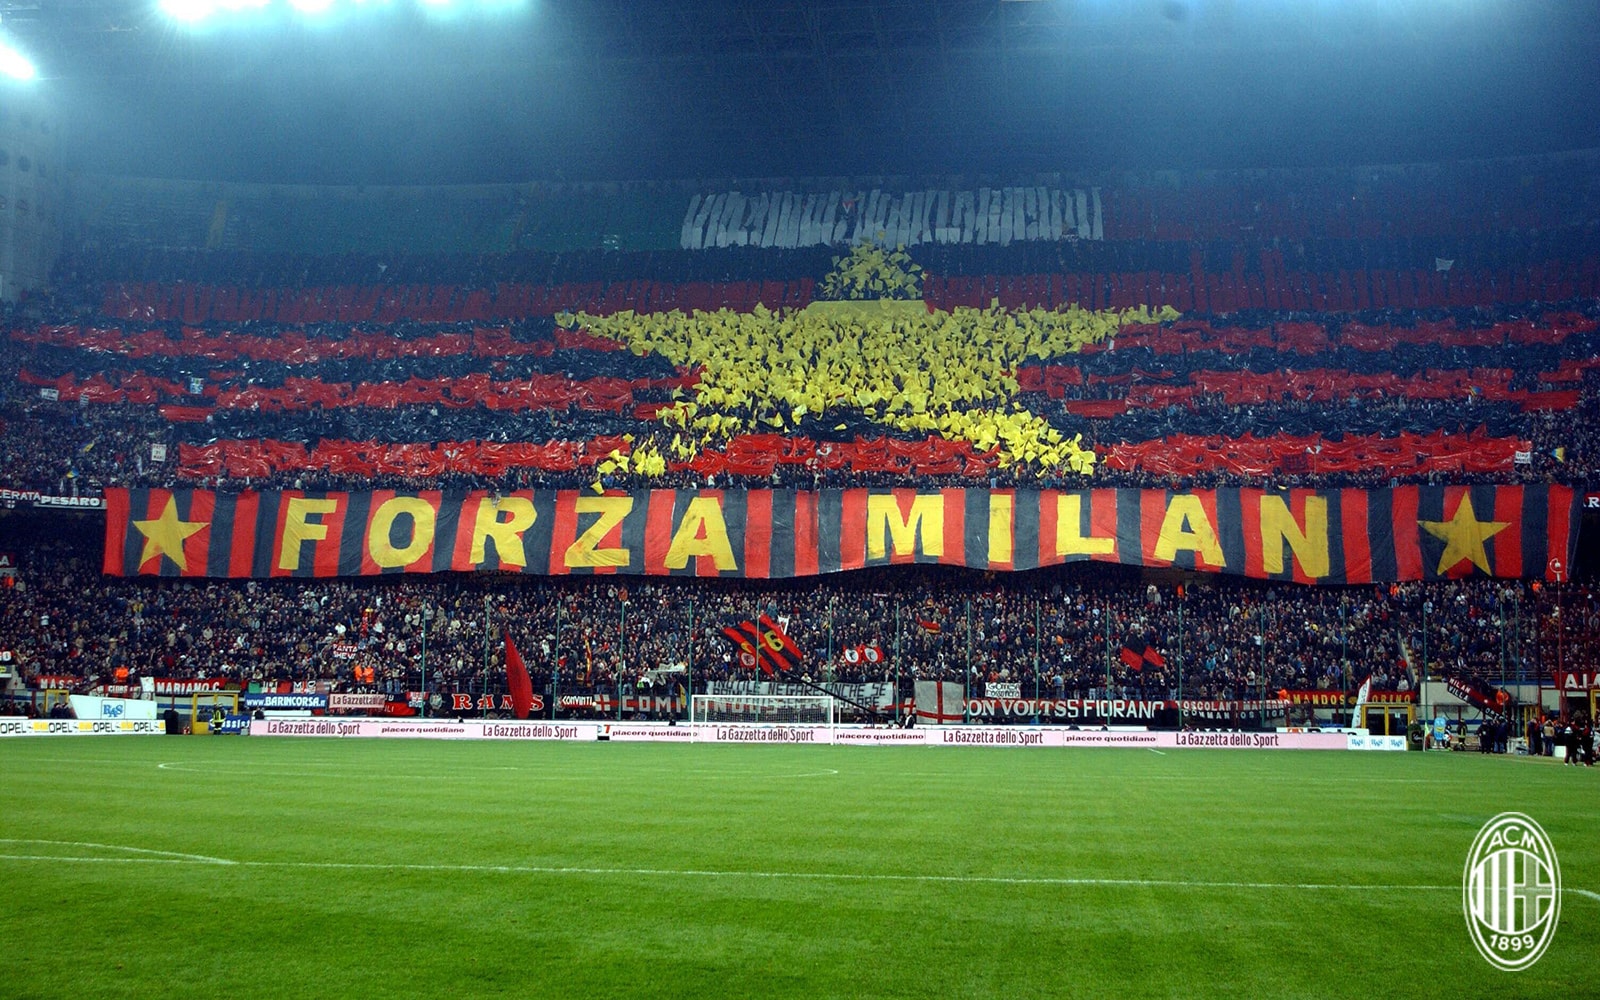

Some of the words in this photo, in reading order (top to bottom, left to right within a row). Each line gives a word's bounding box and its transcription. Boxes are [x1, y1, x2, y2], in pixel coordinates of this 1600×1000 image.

[0, 489, 40, 501] ERATA
[41, 496, 100, 506] PESARO
[1583, 496, 1600, 508] R
[279, 496, 738, 571] FORZA
[867, 494, 1330, 577] MILAN
[156, 681, 209, 695] MARIANO
[333, 696, 342, 705] La
[1372, 694, 1411, 703] ORINO
[103, 704, 124, 718] RAS
[0, 722, 27, 734] OPEL
[48, 722, 73, 734] OPEL
[92, 722, 115, 733] OPEL
[133, 722, 154, 732] OPEL
[268, 721, 276, 733] La
[278, 721, 314, 733] Gazzetta
[316, 721, 335, 733] dello
[337, 721, 360, 735] Sport
[483, 725, 492, 737] La
[494, 725, 531, 737] Gazzetta
[532, 725, 552, 737] dello
[554, 725, 578, 739] Sport
[717, 729, 726, 740] La
[728, 729, 765, 740] Gazzetta
[768, 729, 788, 740] dello
[790, 729, 814, 742] Sport
[944, 731, 953, 743] La
[955, 731, 994, 743] Gazzetta
[996, 731, 1016, 743] dello
[1018, 731, 1043, 745] Sport
[1176, 733, 1186, 745] La
[1188, 733, 1228, 745] Gazzetta
[1230, 733, 1250, 745] dello
[1253, 733, 1279, 747] Sport
